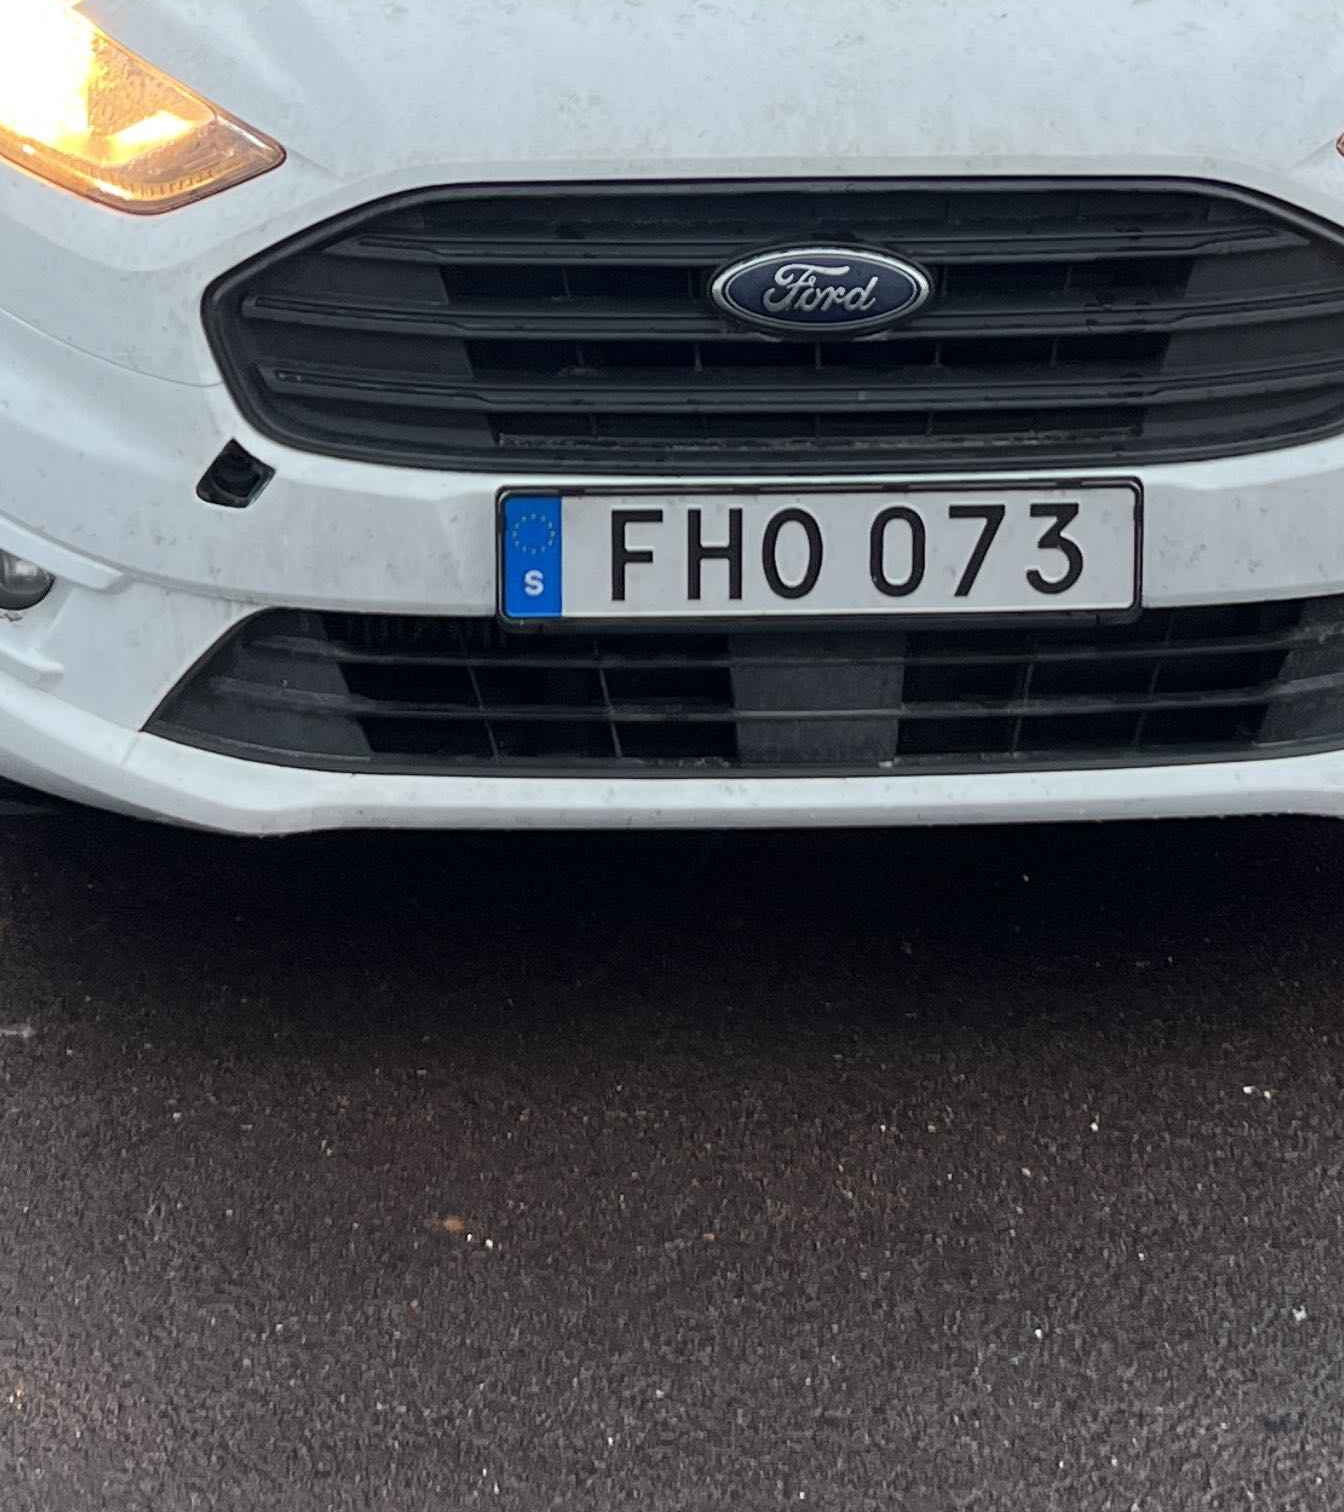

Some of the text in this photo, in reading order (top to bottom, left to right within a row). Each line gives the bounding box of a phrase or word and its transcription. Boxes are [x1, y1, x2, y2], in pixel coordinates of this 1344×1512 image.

[762, 263, 879, 313] Ford
[611, 502, 1085, 602] FHO 073
[524, 570, 545, 596] S
